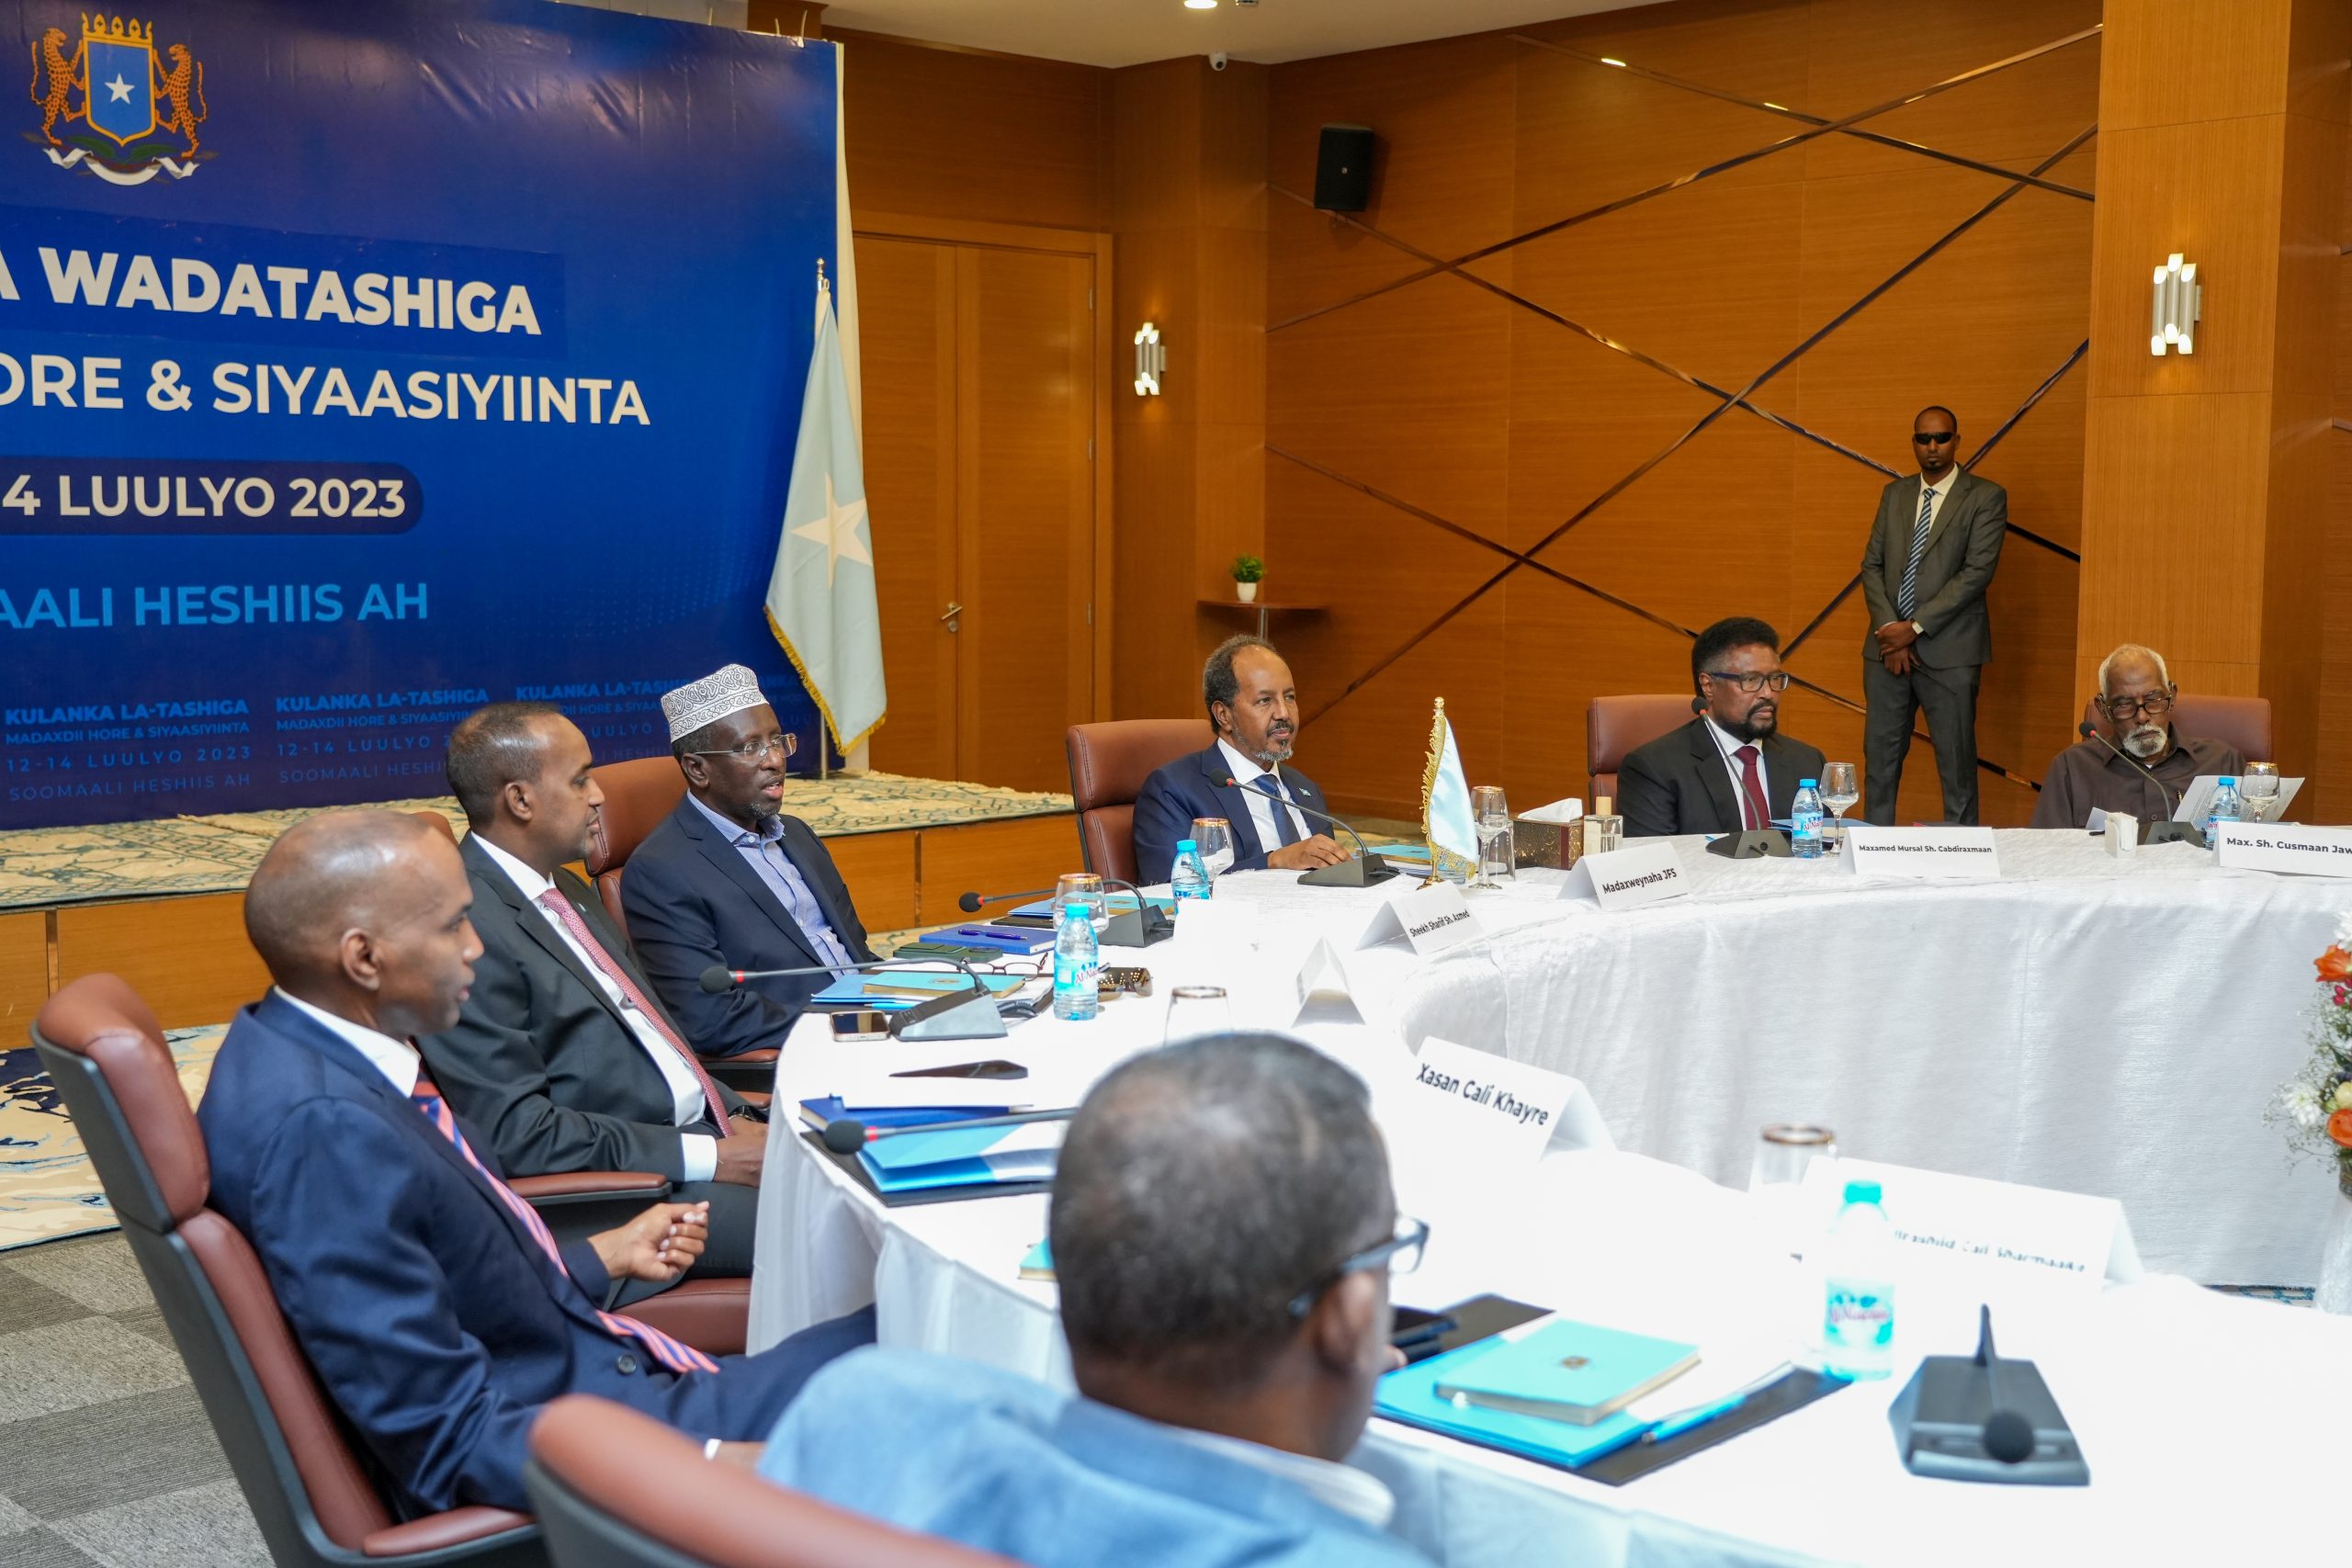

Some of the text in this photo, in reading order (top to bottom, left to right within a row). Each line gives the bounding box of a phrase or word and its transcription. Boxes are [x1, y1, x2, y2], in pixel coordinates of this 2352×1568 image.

[39, 246, 541, 335] WADATASHIGA
[146, 359, 193, 412] &
[212, 362, 650, 425] SIYAASIYIINTA
[59, 475, 275, 518] LUULYO
[289, 478, 406, 518] 2023
[135, 583, 344, 626] HESHIIS
[357, 582, 427, 621] AH
[276, 689, 490, 712] KULANKA LA-TASHIGA
[515, 683, 600, 700] KULANKA
[5, 699, 250, 726] KULANKA LA-TASHIGA
[580, 703, 611, 716] HORE
[6, 722, 250, 745] MADAXDII HORE & SIYAASIYIINTA
[277, 716, 345, 731] MADAXDII
[348, 715, 385, 727] HORE
[389, 714, 397, 725] &
[591, 723, 652, 738] UULYO
[348, 736, 431, 752] LUULYO
[88, 750, 182, 768] LUULYO
[197, 746, 250, 761] 2023
[279, 766, 378, 784] SOOMAALI
[9, 773, 250, 802] SOOMAALI HESHIIS AH
[1859, 844, 1993, 853] Maxamed Mursal Sh. Cabdiraxmaan
[2227, 837, 2253, 847] Max.
[2256, 840, 2274, 849] Sh.
[2277, 840, 2329, 852] Cusmaan
[1602, 868, 1677, 894] Madaxweynaha JFS
[1409, 923, 1430, 937] Sheekh
[1416, 1063, 1549, 1125] Xasan Cali Khayre
